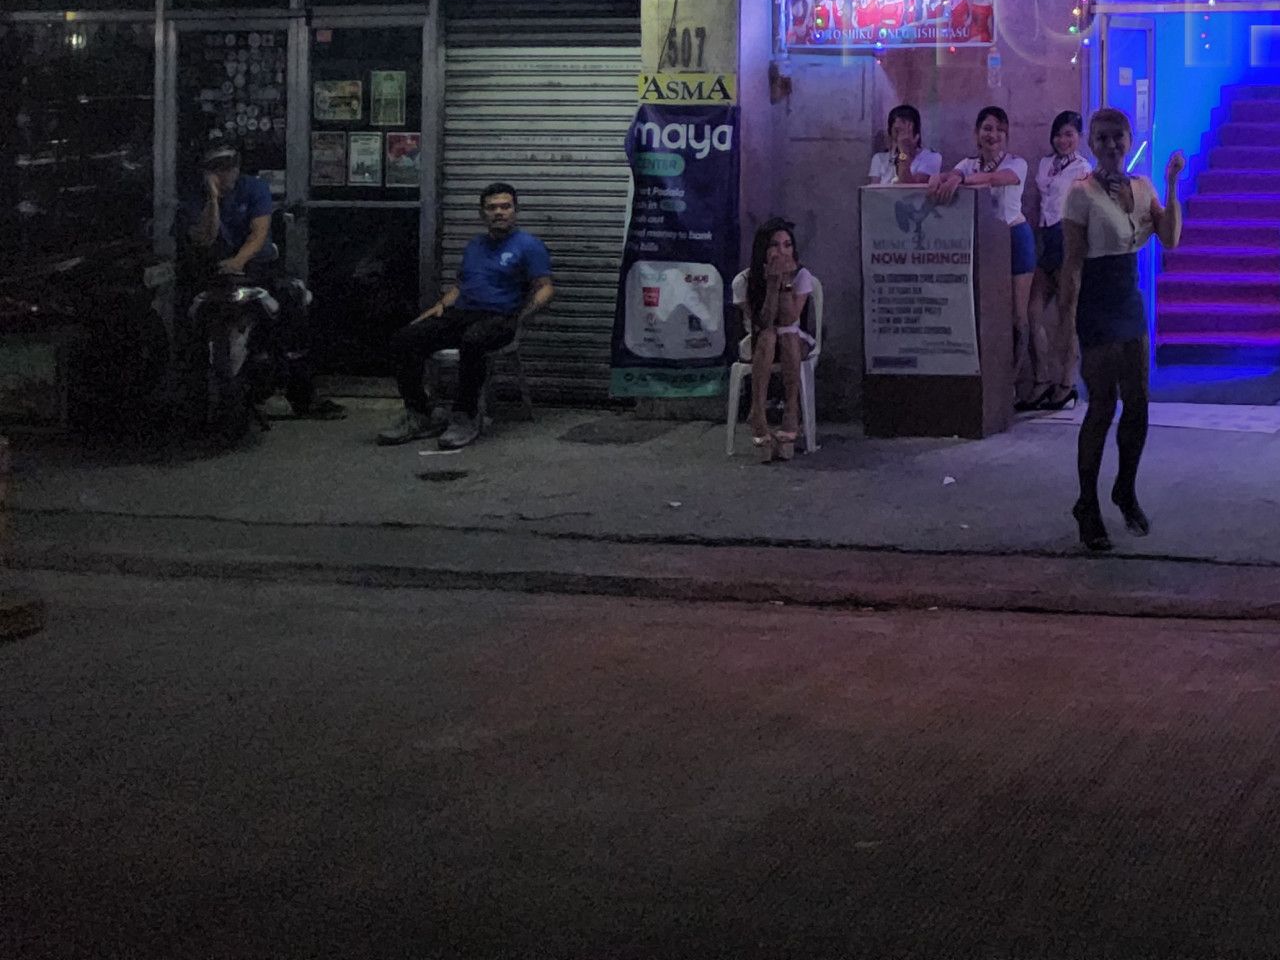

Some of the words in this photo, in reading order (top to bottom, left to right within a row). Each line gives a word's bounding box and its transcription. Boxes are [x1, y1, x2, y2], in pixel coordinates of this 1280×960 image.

[634, 121, 733, 160] maya
[871, 253, 907, 265] NOW
[911, 252, 971, 265] HIRING!!!
